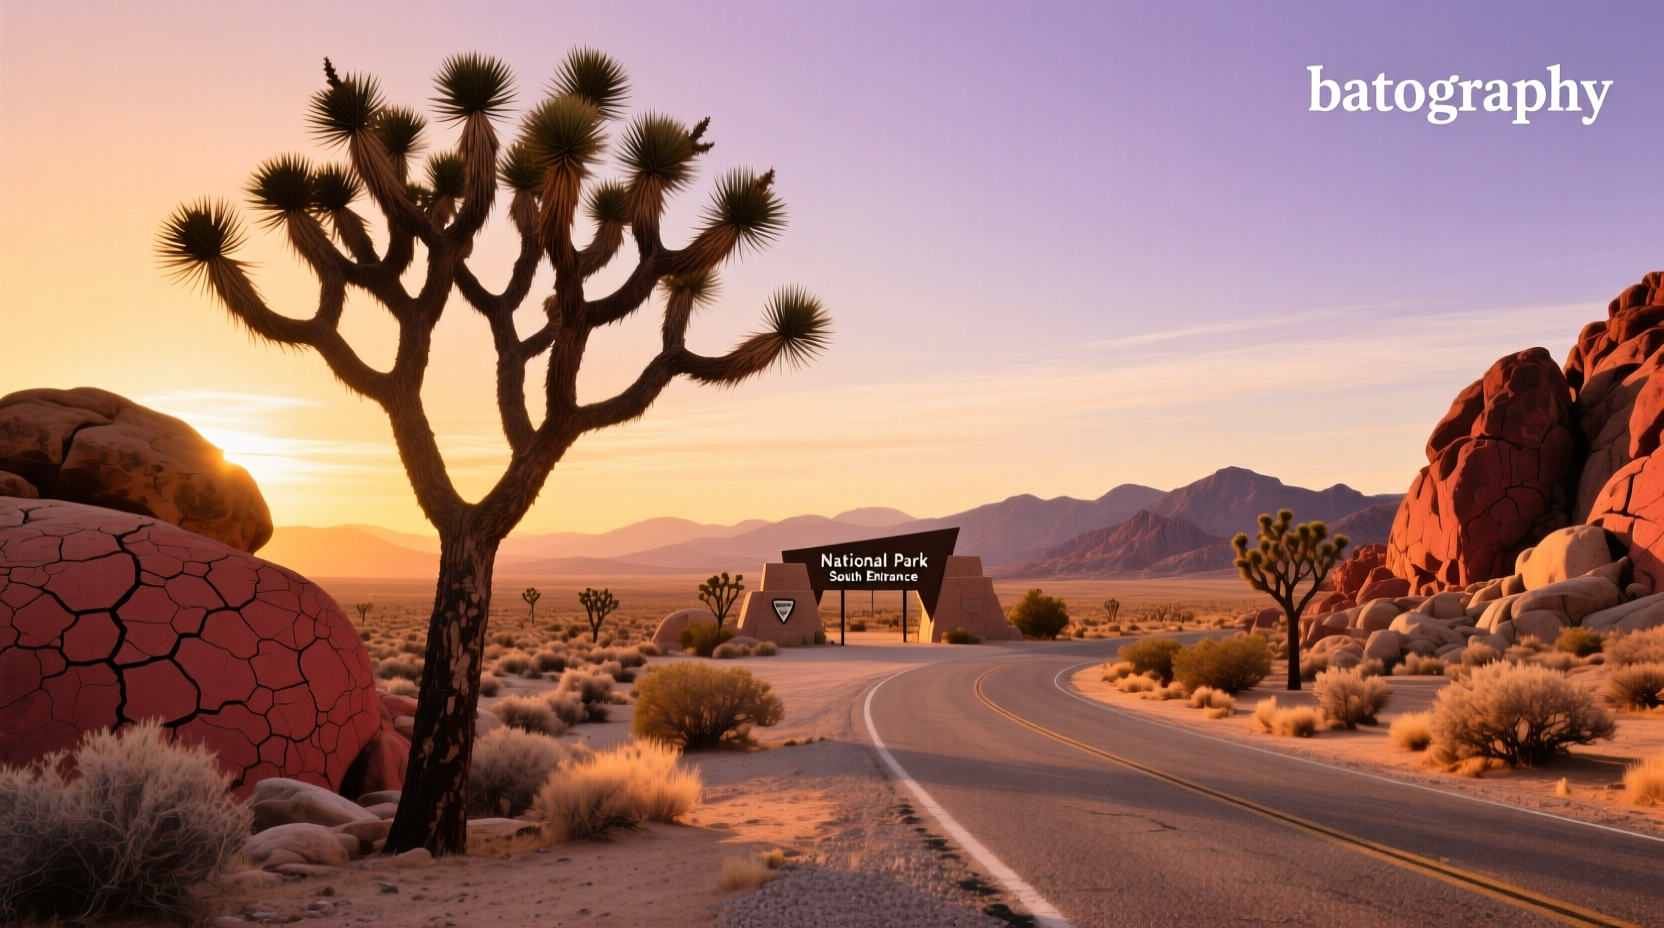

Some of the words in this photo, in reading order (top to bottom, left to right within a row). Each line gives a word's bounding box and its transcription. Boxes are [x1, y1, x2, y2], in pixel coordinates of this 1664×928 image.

[821, 552, 887, 568] National
[894, 551, 928, 568] Park
[829, 570, 862, 582] South
[866, 570, 919, 582] Entrance
